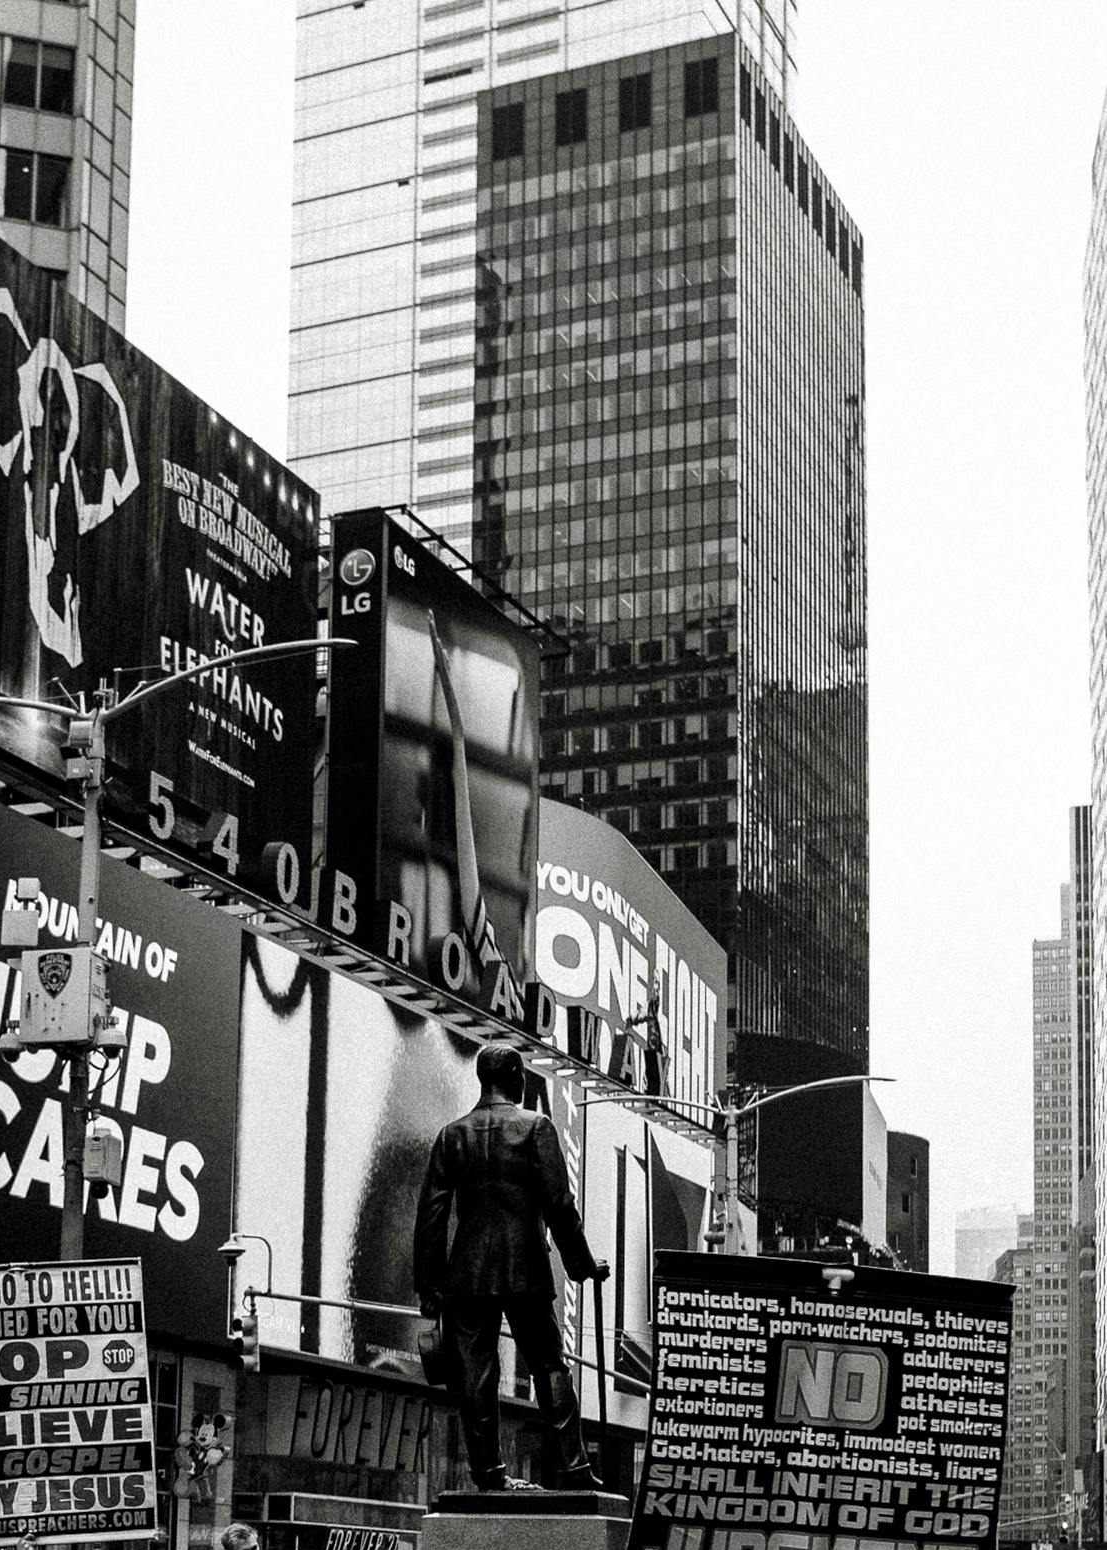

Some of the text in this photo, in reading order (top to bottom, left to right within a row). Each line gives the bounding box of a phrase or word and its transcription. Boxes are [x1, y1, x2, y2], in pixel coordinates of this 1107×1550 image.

[162, 458, 199, 502] BEST
[202, 477, 236, 522] NEW
[236, 506, 292, 579] MUSICAL
[185, 567, 266, 648] WATER
[341, 592, 371, 615] LG
[160, 635, 284, 743] ELEPHANTS
[198, 707, 257, 751] NEW MUSICAL
[536, 860, 651, 949] YOU ONLY GET
[143, 941, 179, 984] OF
[535, 905, 650, 1042] ONE
[25, 1271, 54, 1304] TO
[62, 1268, 133, 1302] HELL!!
[37, 1306, 78, 1335] FOR
[85, 1303, 136, 1333] YOU!
[657, 1307, 1008, 1355] drunkards, porn-watchers, sodomites
[658, 1286, 1009, 1335] fornicators, homosexuals, thieves
[104, 1348, 134, 1365] STOP
[657, 1331, 768, 1353] murderers
[657, 1348, 767, 1374] feminists
[902, 1350, 1006, 1375] adulterers
[9, 1380, 140, 1408] SINNING
[656, 1372, 766, 1397] heretics
[777, 1341, 888, 1430] NO
[901, 1372, 1005, 1398] pedophiles
[289, 1375, 432, 1474] FOREVER
[654, 1397, 764, 1419] extortioners
[896, 1413, 1003, 1438] pot smokers
[900, 1394, 1004, 1418] atheists
[651, 1416, 1001, 1461] lukewarm hypocrites, immodest women
[3, 1445, 142, 1476] GOSPEL
[651, 1438, 998, 1482] God-haters, abortionists, liars
[30, 1474, 146, 1514] JESUS
[647, 1463, 996, 1510] SHALL INHERIT THE
[643, 1491, 990, 1538] KINGDOM OF GOD
